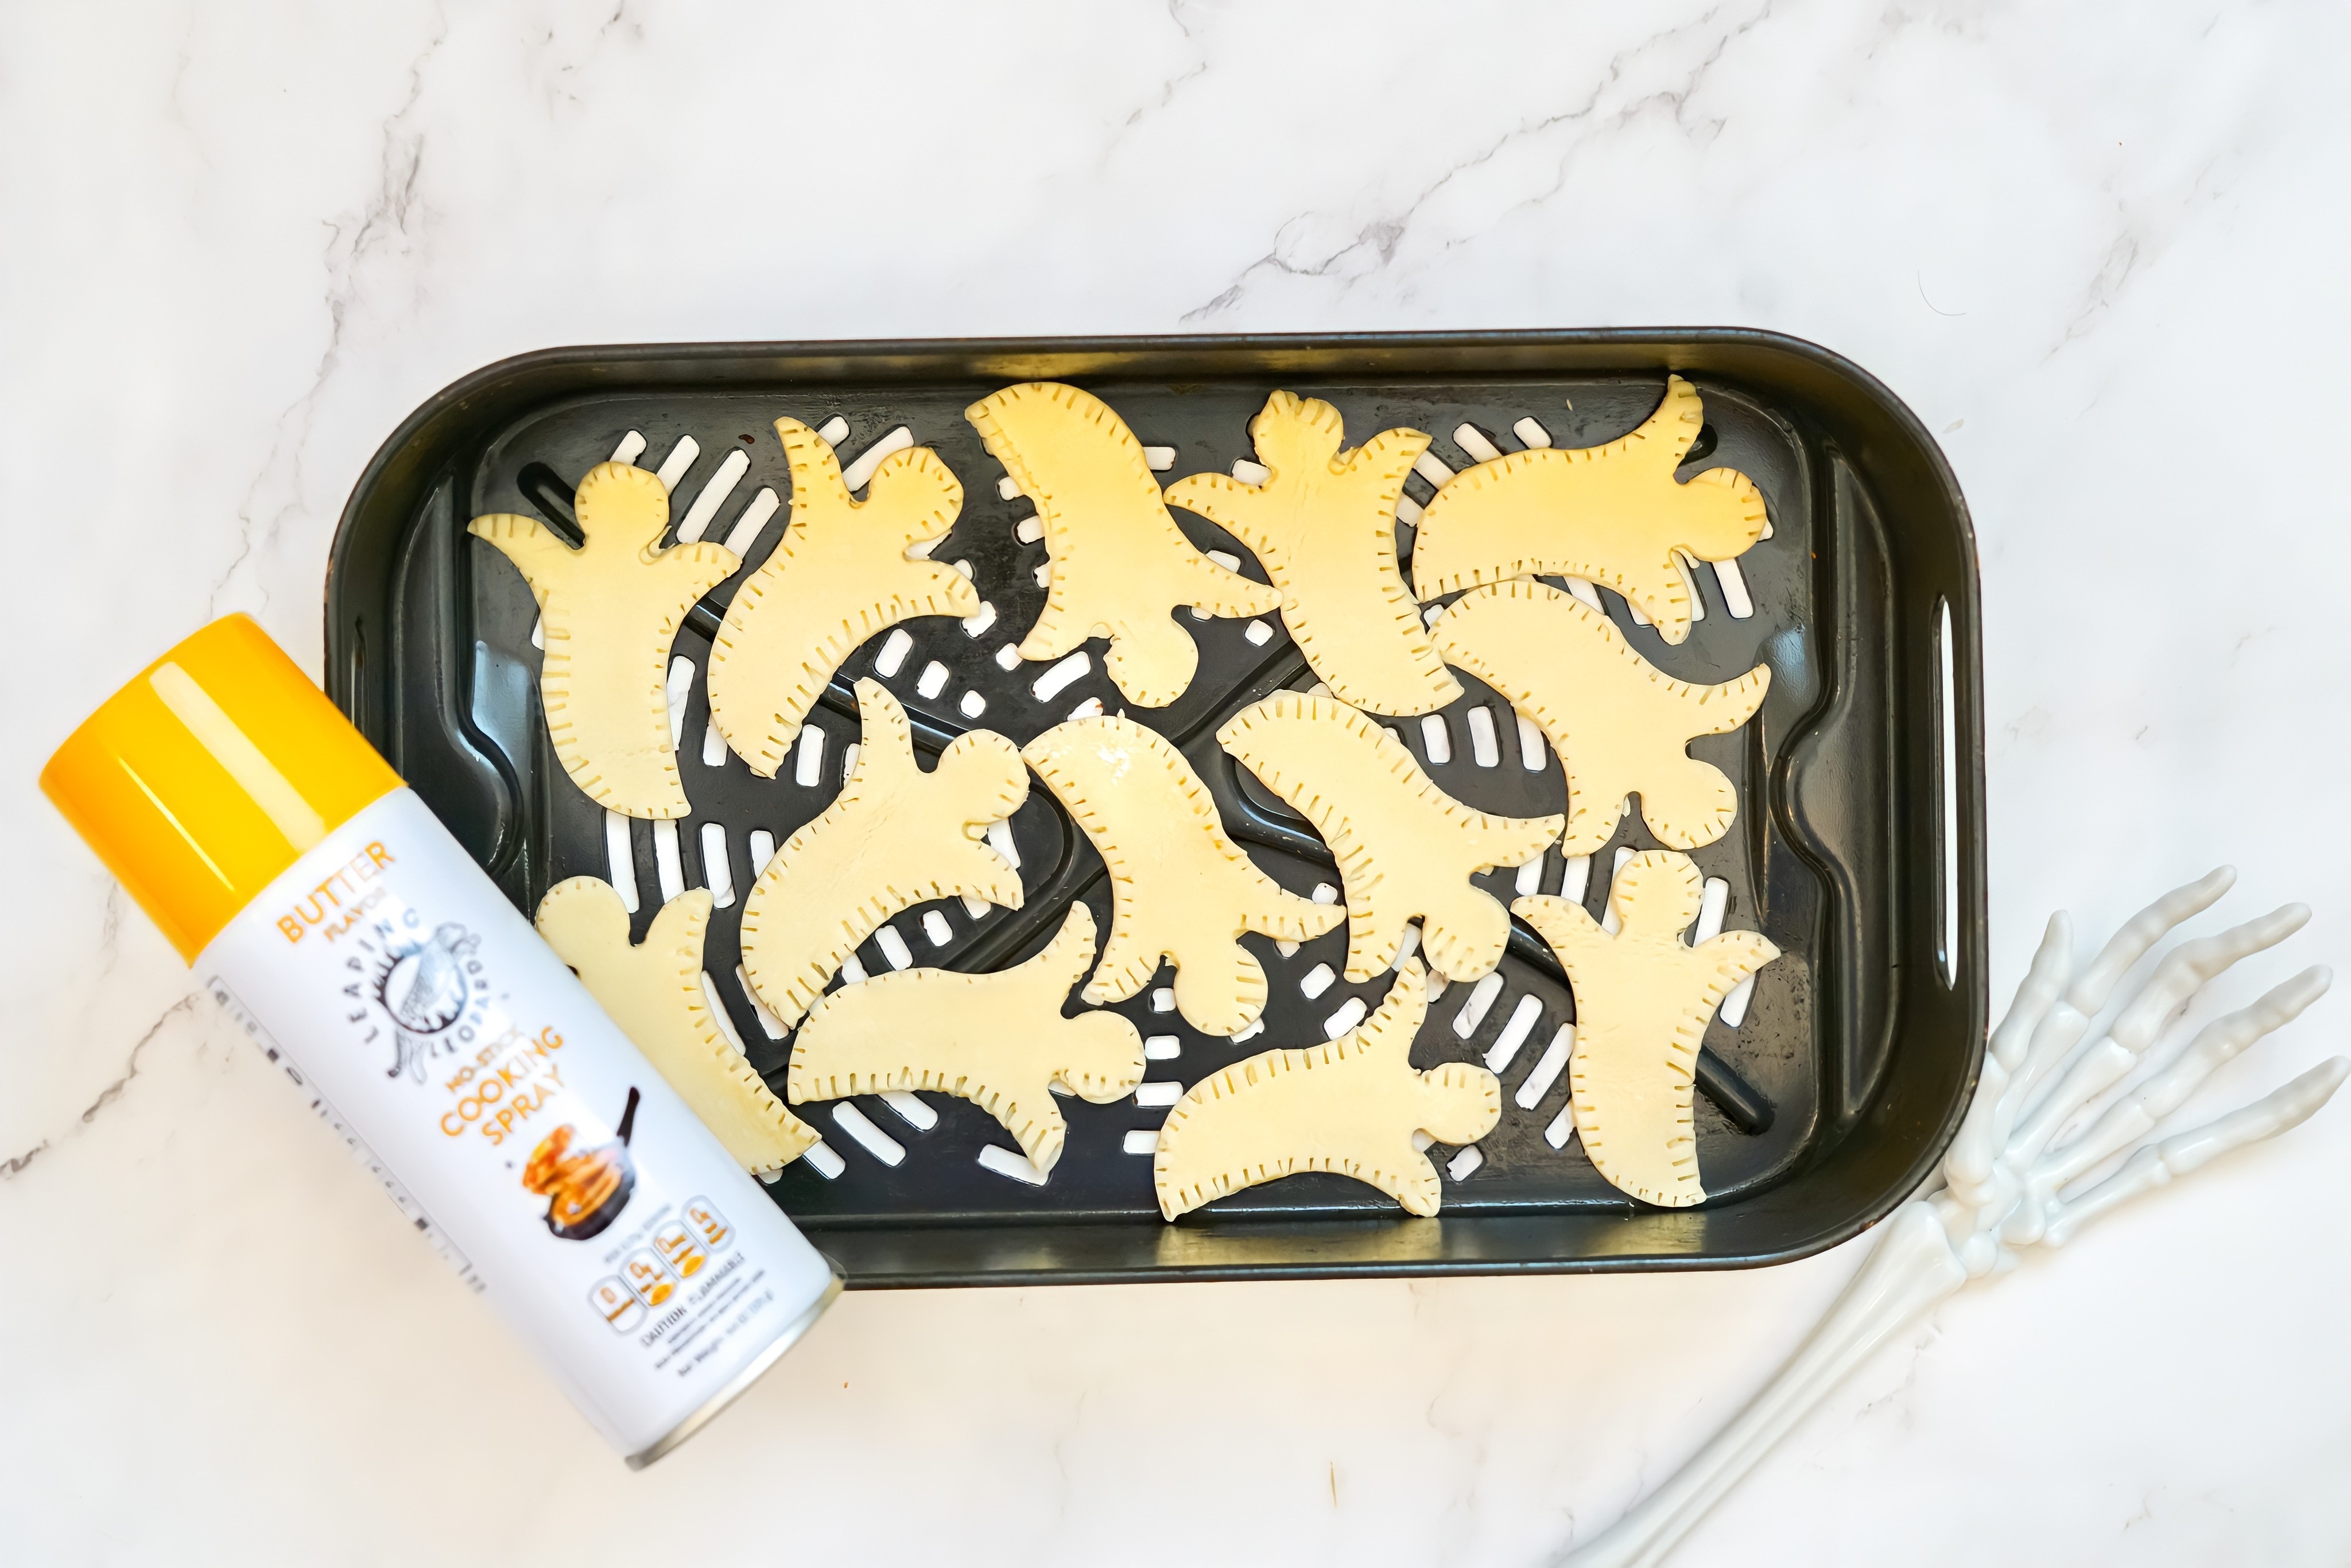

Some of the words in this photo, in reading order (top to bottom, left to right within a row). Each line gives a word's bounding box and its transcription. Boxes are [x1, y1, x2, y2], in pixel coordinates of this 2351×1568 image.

[276, 840, 395, 944] BUTTER
[323, 887, 387, 942] FLAVOR
[343, 907, 420, 1045] LEAPING
[440, 1026, 564, 1137] COOKING
[481, 1064, 565, 1146] SPRAY
